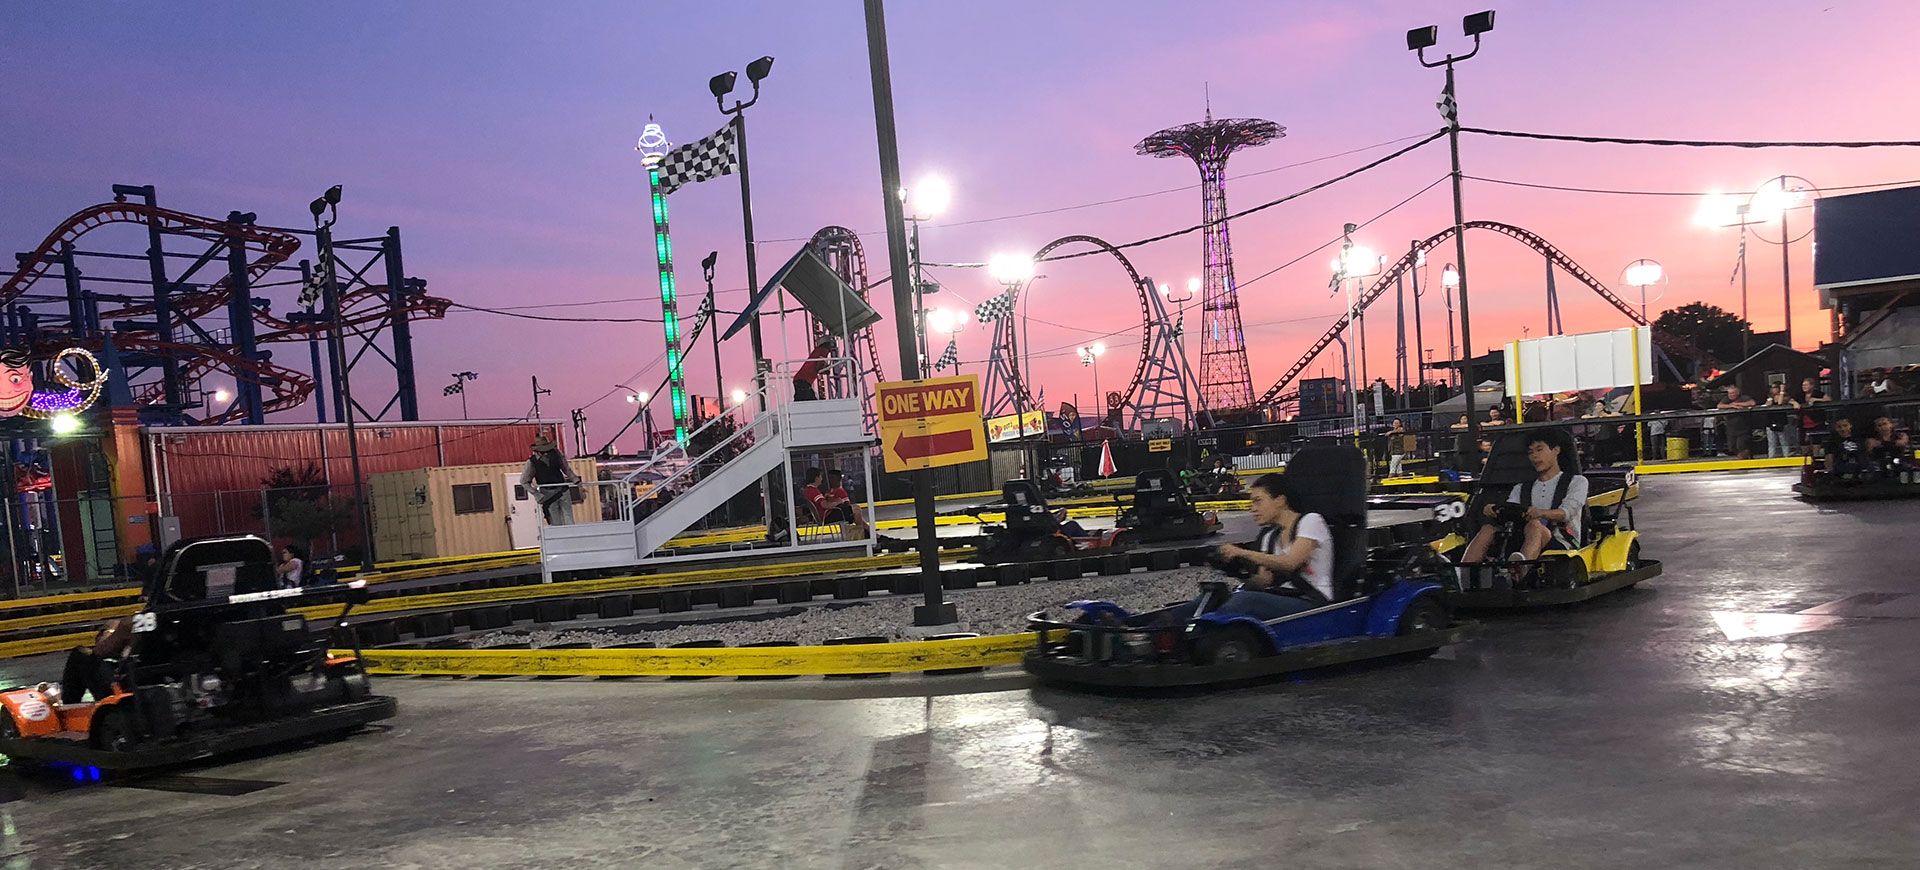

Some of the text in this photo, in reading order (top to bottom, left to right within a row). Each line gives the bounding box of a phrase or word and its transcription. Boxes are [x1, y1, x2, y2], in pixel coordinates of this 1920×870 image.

[884, 387, 970, 415] ONE WAY
[1434, 501, 1466, 522] 30
